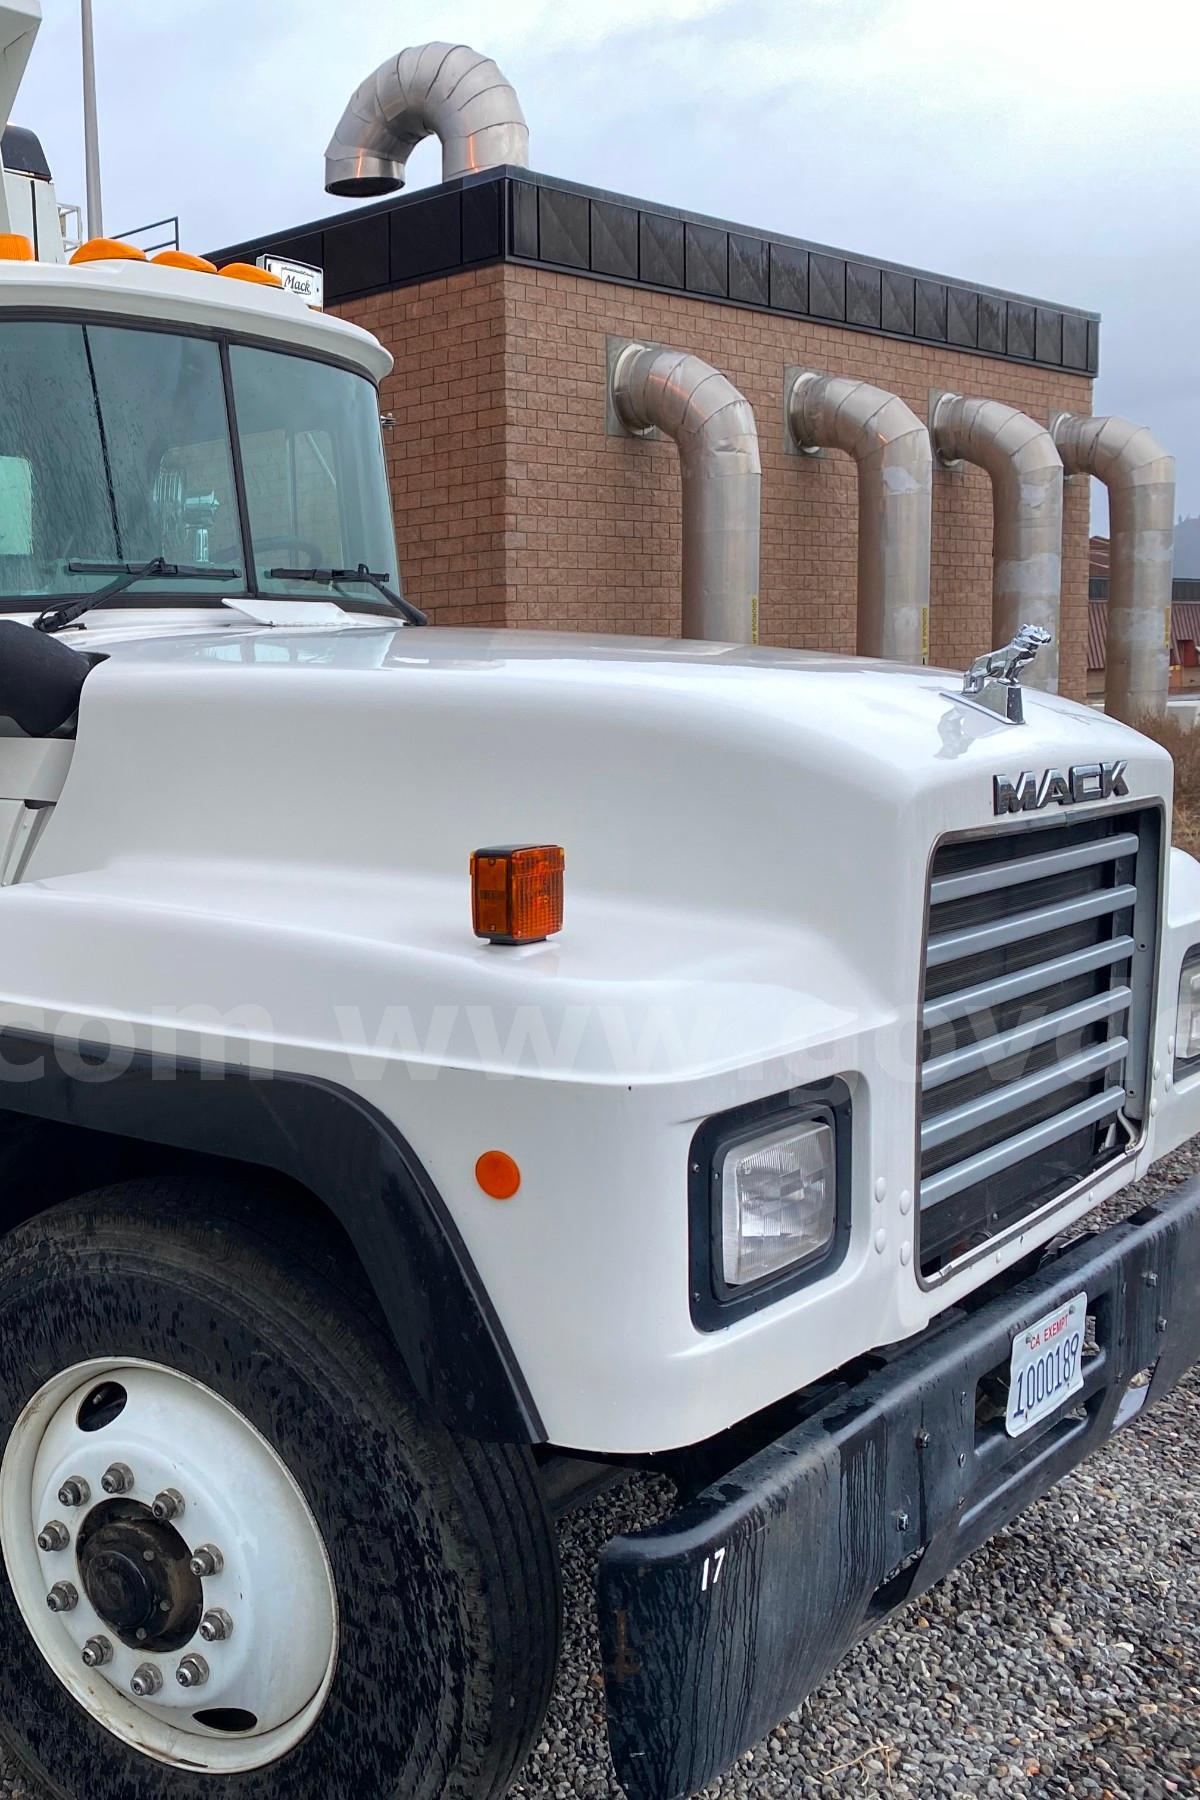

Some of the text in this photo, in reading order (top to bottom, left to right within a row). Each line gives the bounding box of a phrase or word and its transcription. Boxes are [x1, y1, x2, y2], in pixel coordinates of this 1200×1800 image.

[284, 275, 311, 293] Mack
[993, 760, 1130, 816] MACK
[1030, 1314, 1069, 1350] CA EXEMPT
[1013, 1332, 1080, 1418] 1000189
[702, 1547, 726, 1591] 17
